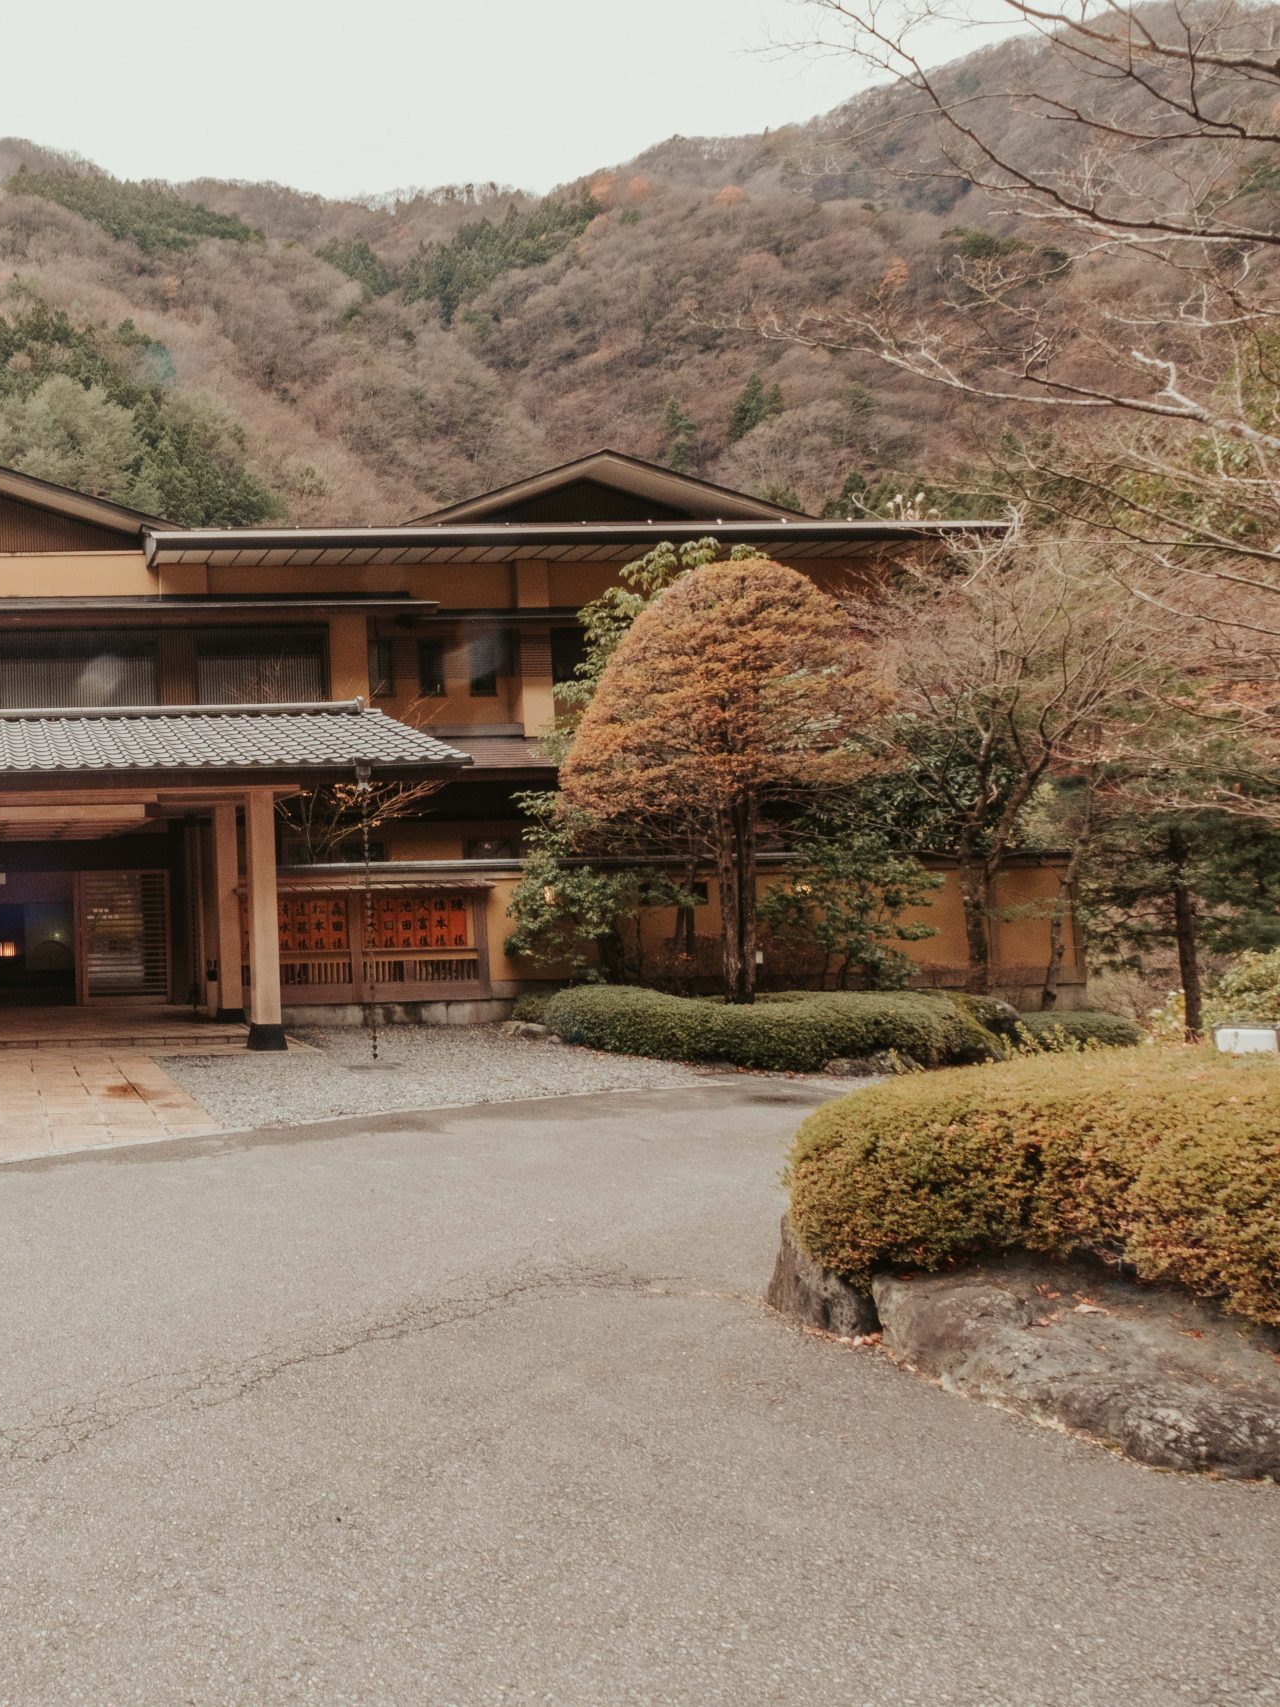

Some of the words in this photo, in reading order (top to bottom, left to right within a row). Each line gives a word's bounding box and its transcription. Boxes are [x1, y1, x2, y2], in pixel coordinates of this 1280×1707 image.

[312, 902, 326, 950] 松本様
[382, 901, 396, 948] 山口様
[400, 901, 413, 947] 池田様
